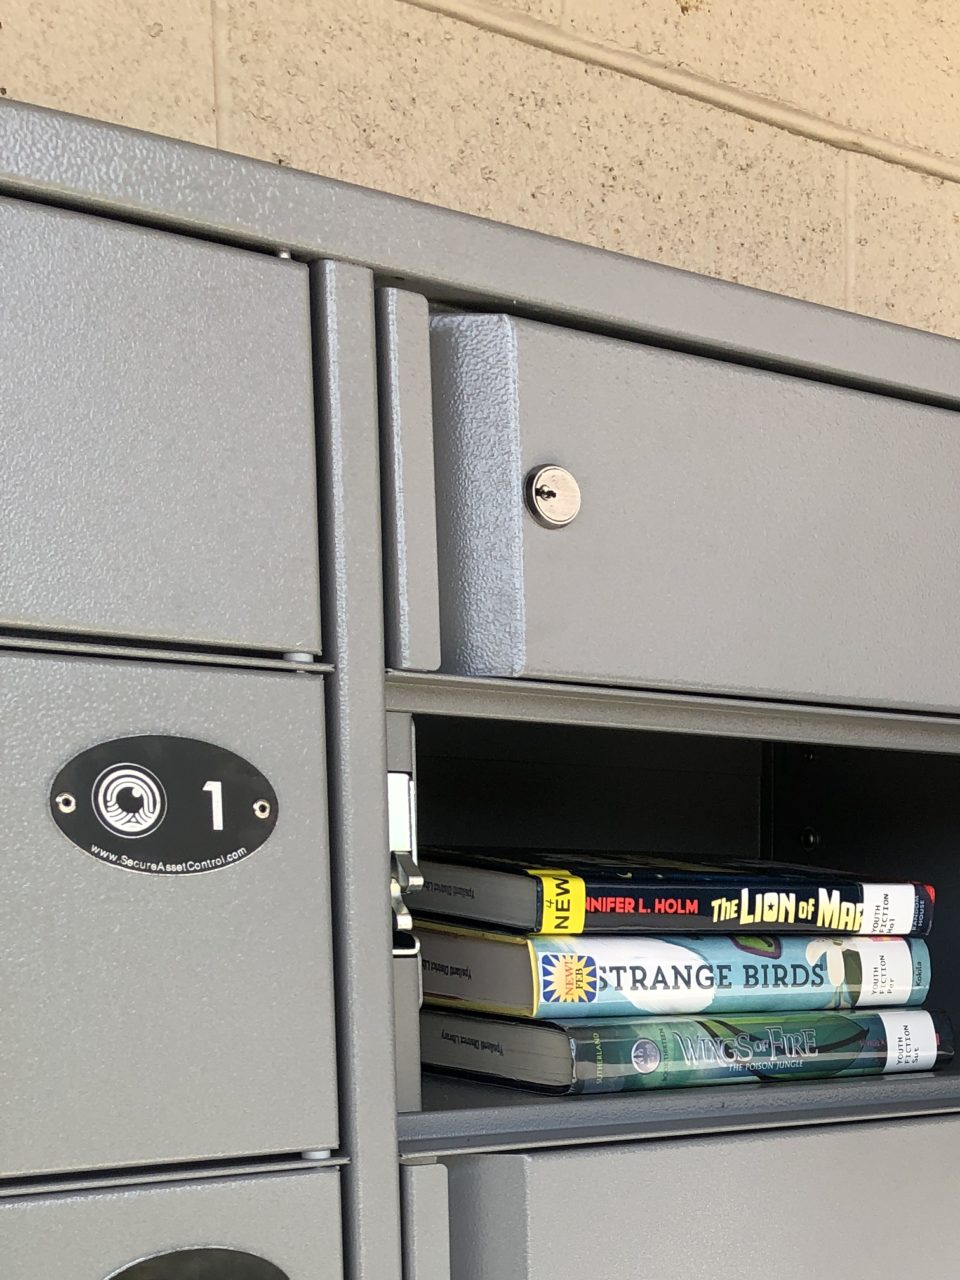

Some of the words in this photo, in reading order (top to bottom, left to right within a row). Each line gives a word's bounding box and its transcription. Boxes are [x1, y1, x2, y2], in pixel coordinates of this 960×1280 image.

[202, 780, 224, 831] 1
[90, 843, 248, 873] www.SecureAssetControl.com
[554, 876, 571, 931] NEW
[585, 896, 635, 913] NNIFER
[638, 898, 651, 913] L.
[654, 898, 699, 914] HOLM
[739, 887, 796, 925] LION
[816, 887, 864, 932] MAR
[871, 904, 881, 933] YOUTH
[879, 893, 890, 933] FICTION
[564, 960, 575, 996] NEW!
[575, 967, 584, 990] FEB
[599, 964, 732, 991] STRANGE
[742, 963, 825, 988] BIRDS
[871, 966, 879, 995] YOUTH
[878, 954, 886, 994] FICTION
[915, 960, 923, 987] Kokila
[593, 1032, 604, 1085] SUTHERLAND
[672, 1031, 754, 1067] WINGS
[765, 1025, 819, 1061] FIRE
[896, 1036, 904, 1066] YOUTH
[729, 1063, 743, 1072] THE
[745, 1061, 774, 1071] POISON
[776, 1060, 804, 1070] JUNGLE
